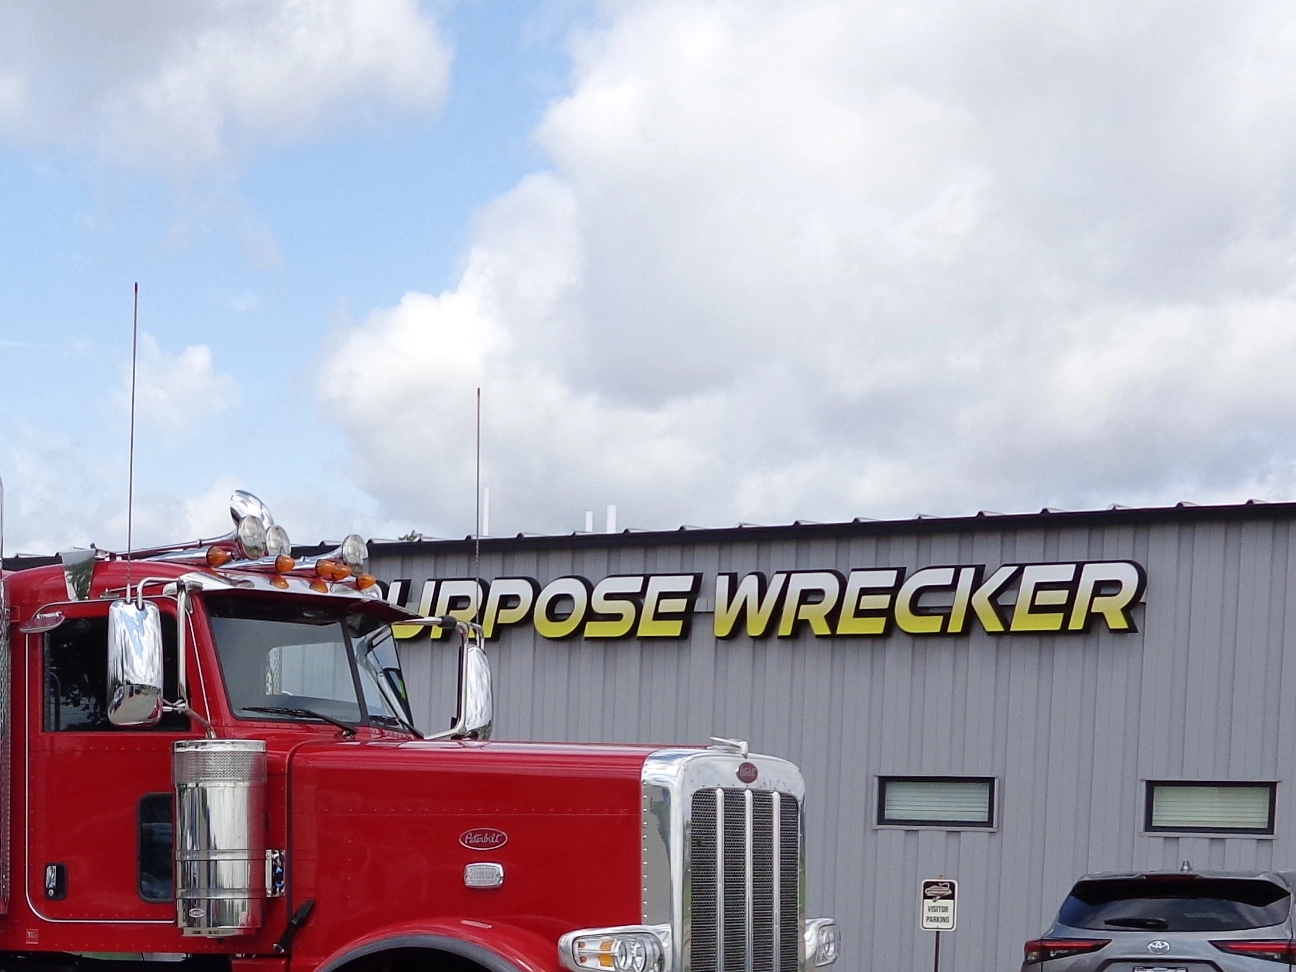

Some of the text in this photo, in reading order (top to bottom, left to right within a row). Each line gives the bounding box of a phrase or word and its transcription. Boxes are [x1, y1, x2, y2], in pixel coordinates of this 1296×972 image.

[376, 560, 1146, 640] URPOSE WRECKER
[464, 832, 503, 844] Peterbilt
[927, 905, 949, 913] VISITOR
[925, 915, 950, 923] PARKING
